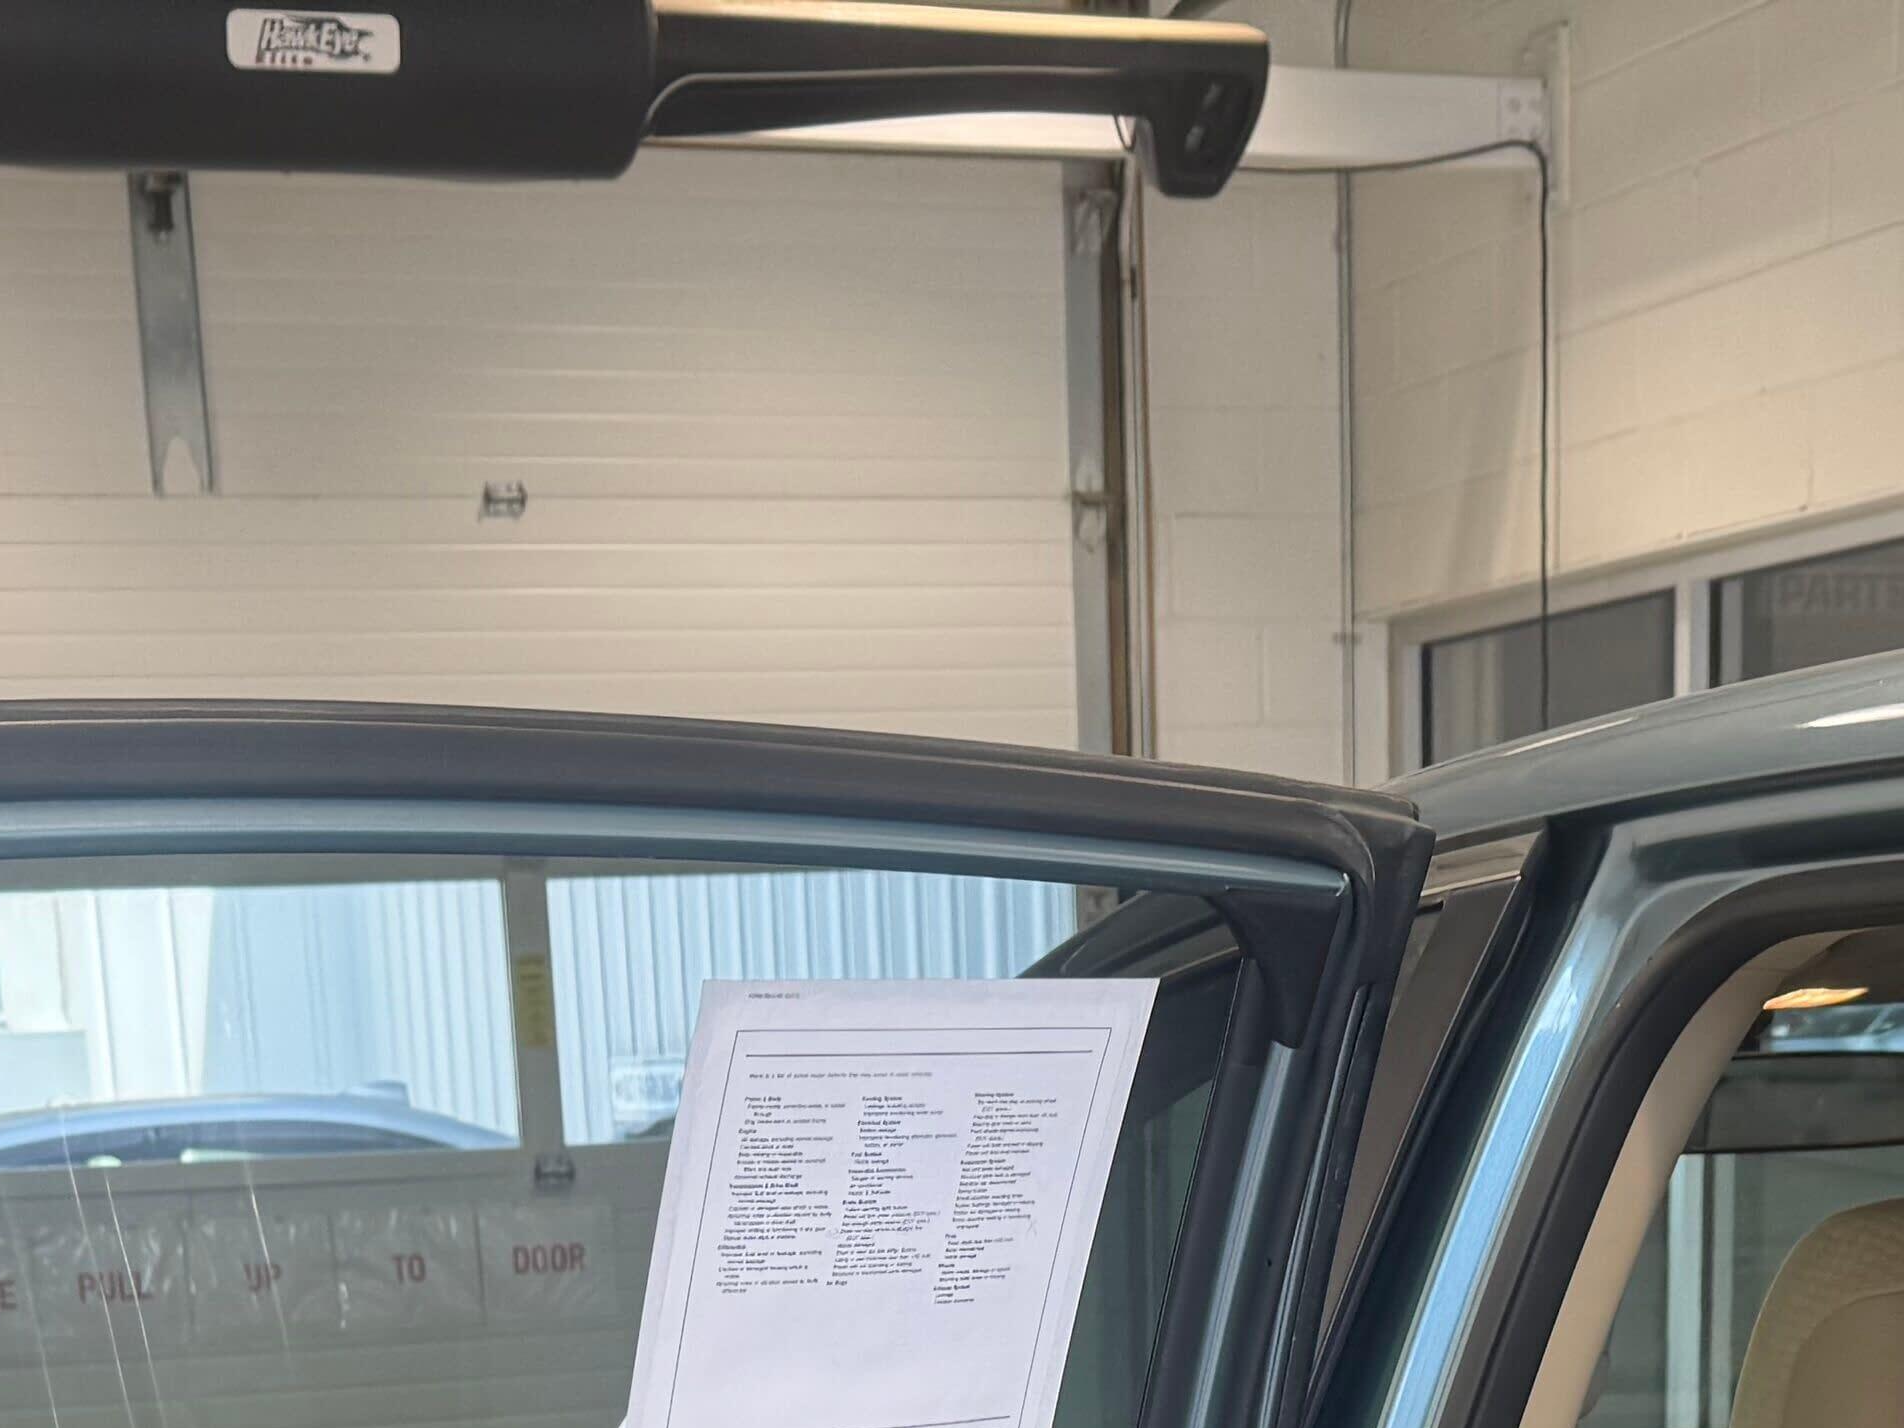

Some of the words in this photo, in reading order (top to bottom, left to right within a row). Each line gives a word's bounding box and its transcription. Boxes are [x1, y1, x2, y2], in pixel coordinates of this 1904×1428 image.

[77, 1270, 153, 1304] PULL
[243, 1262, 283, 1293] UP
[391, 1253, 428, 1284] TO
[511, 1242, 587, 1275] DOOR
